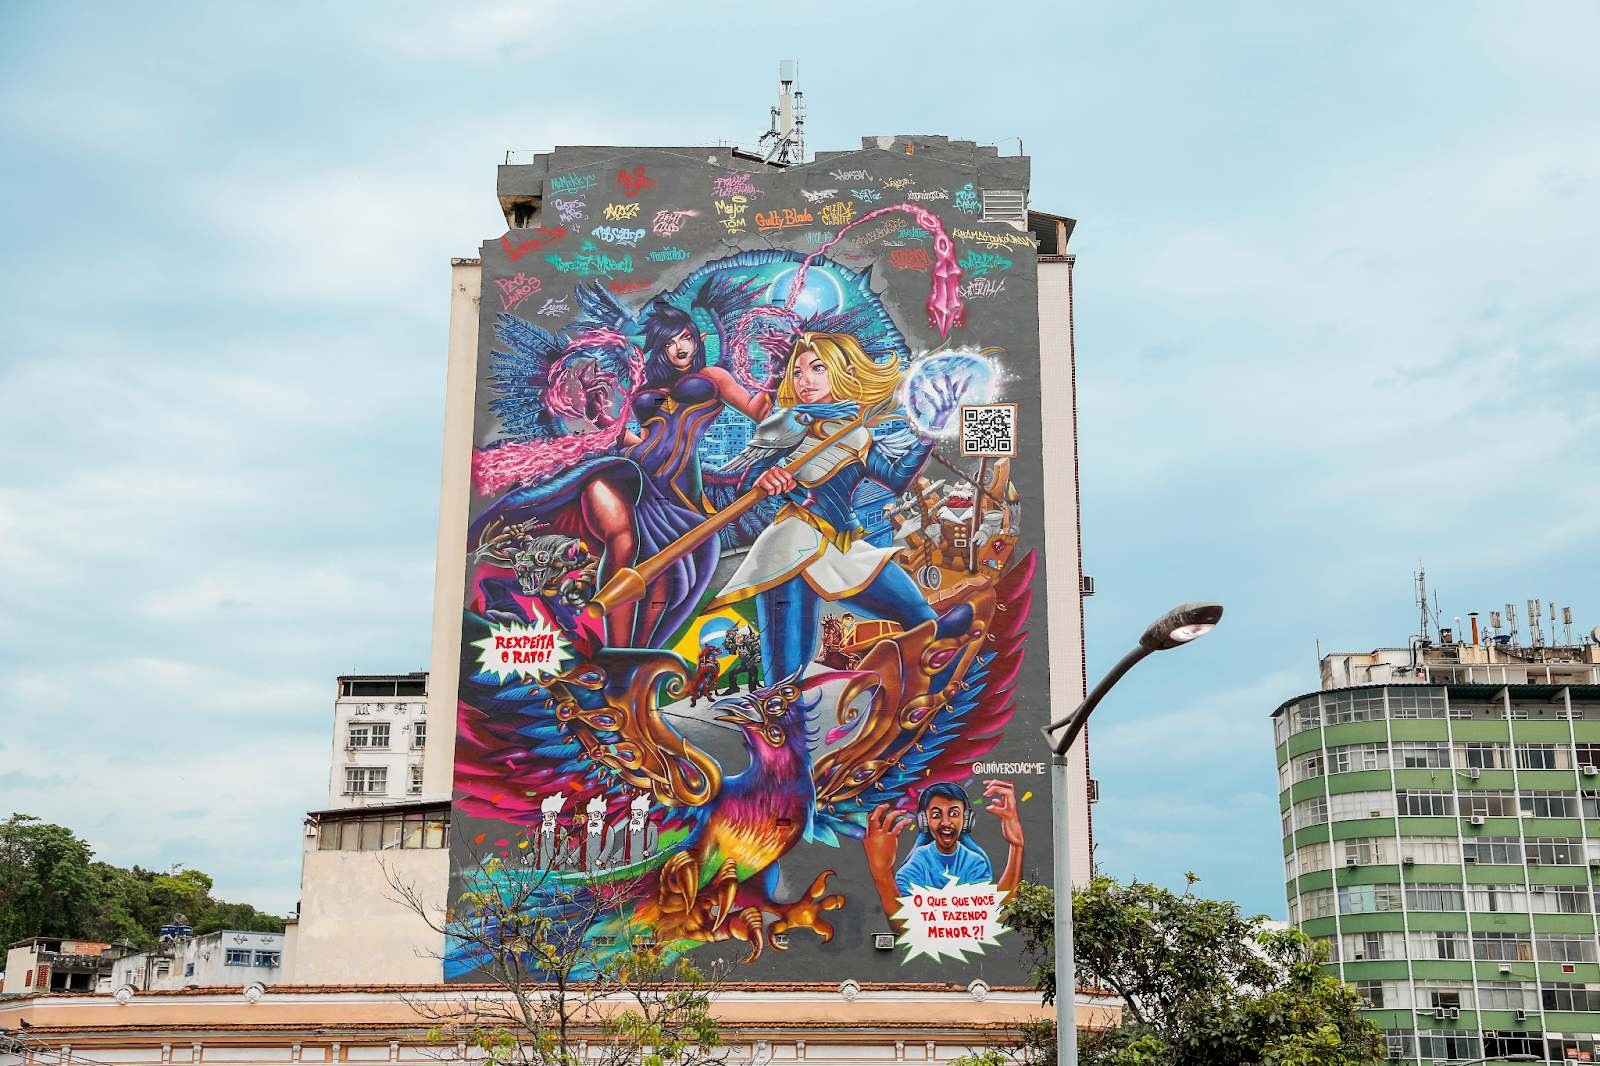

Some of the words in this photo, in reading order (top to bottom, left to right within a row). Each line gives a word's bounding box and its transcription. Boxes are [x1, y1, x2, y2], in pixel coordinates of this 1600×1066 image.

[501, 651, 509, 663] O
[512, 650, 552, 664] RATO!
[914, 895, 922, 907] O
[927, 896, 948, 907] QUE
[951, 896, 970, 907] QUE
[942, 910, 988, 921] FAZENDO
